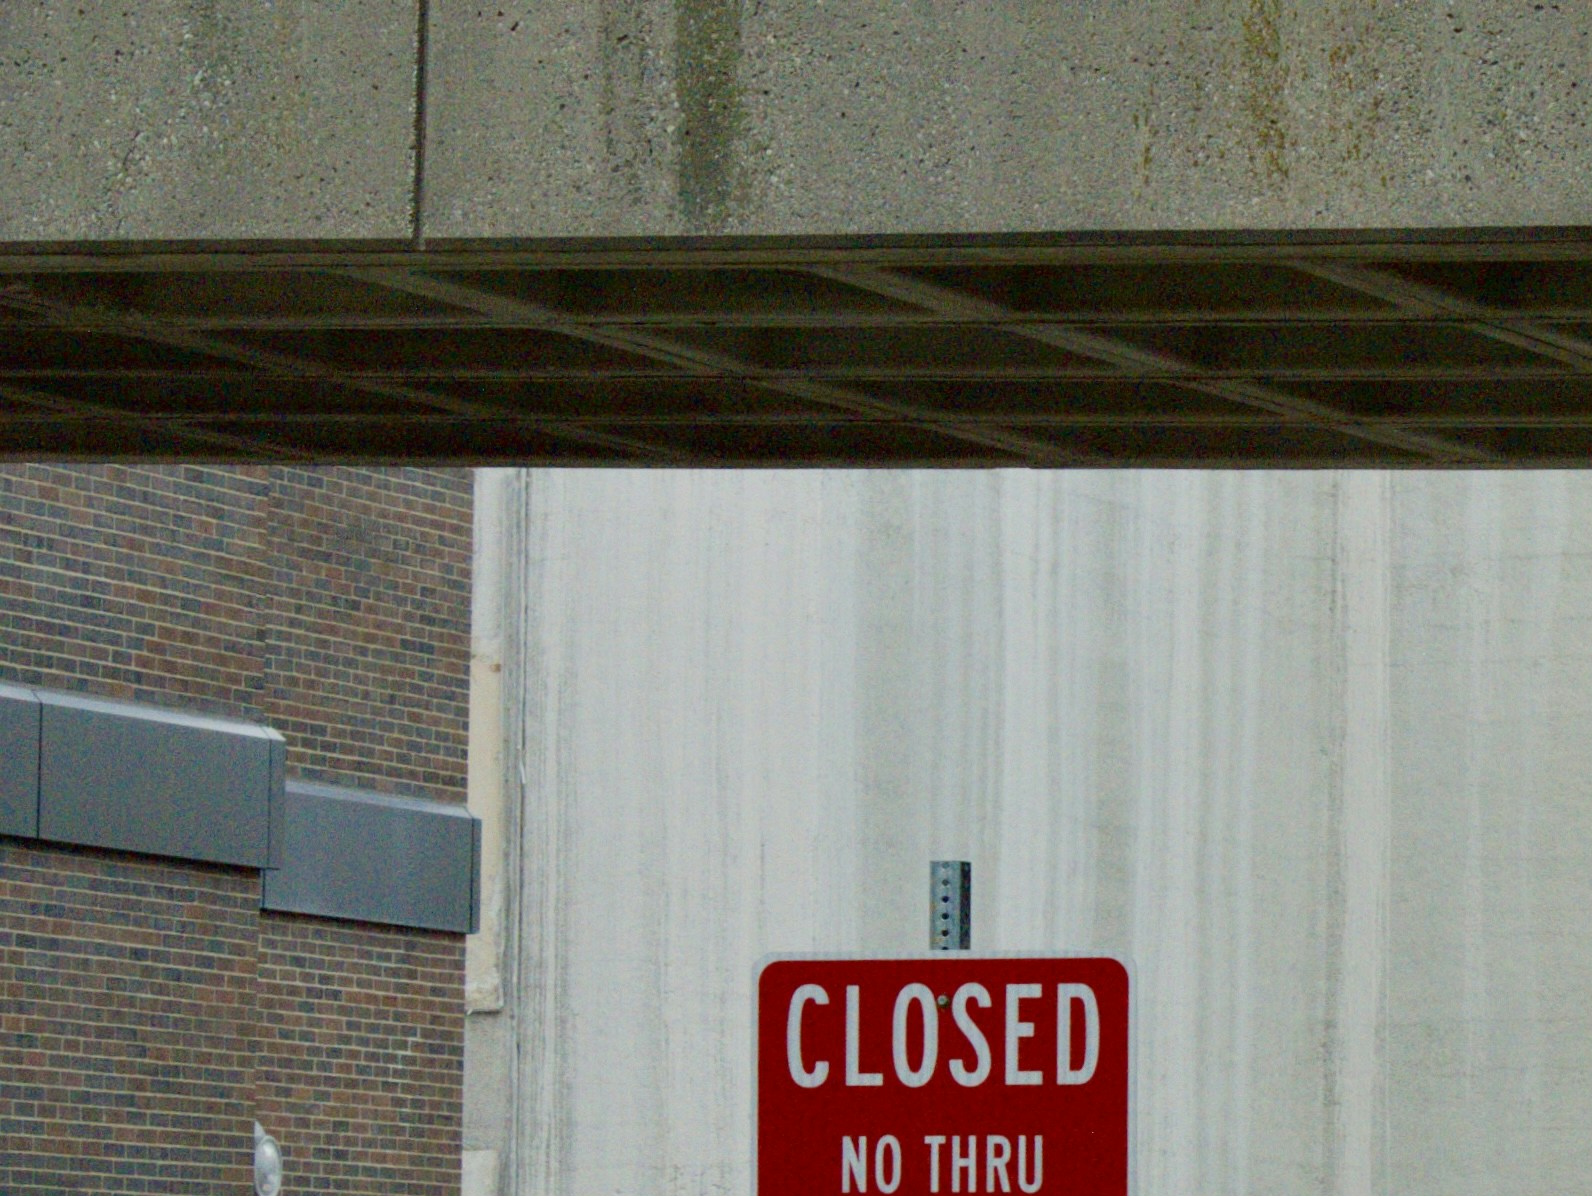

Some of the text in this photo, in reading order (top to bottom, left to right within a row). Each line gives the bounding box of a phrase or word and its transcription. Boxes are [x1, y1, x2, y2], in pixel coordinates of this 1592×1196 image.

[786, 982, 1100, 1088] CLOSED
[841, 1134, 1044, 1194] NO THRU
